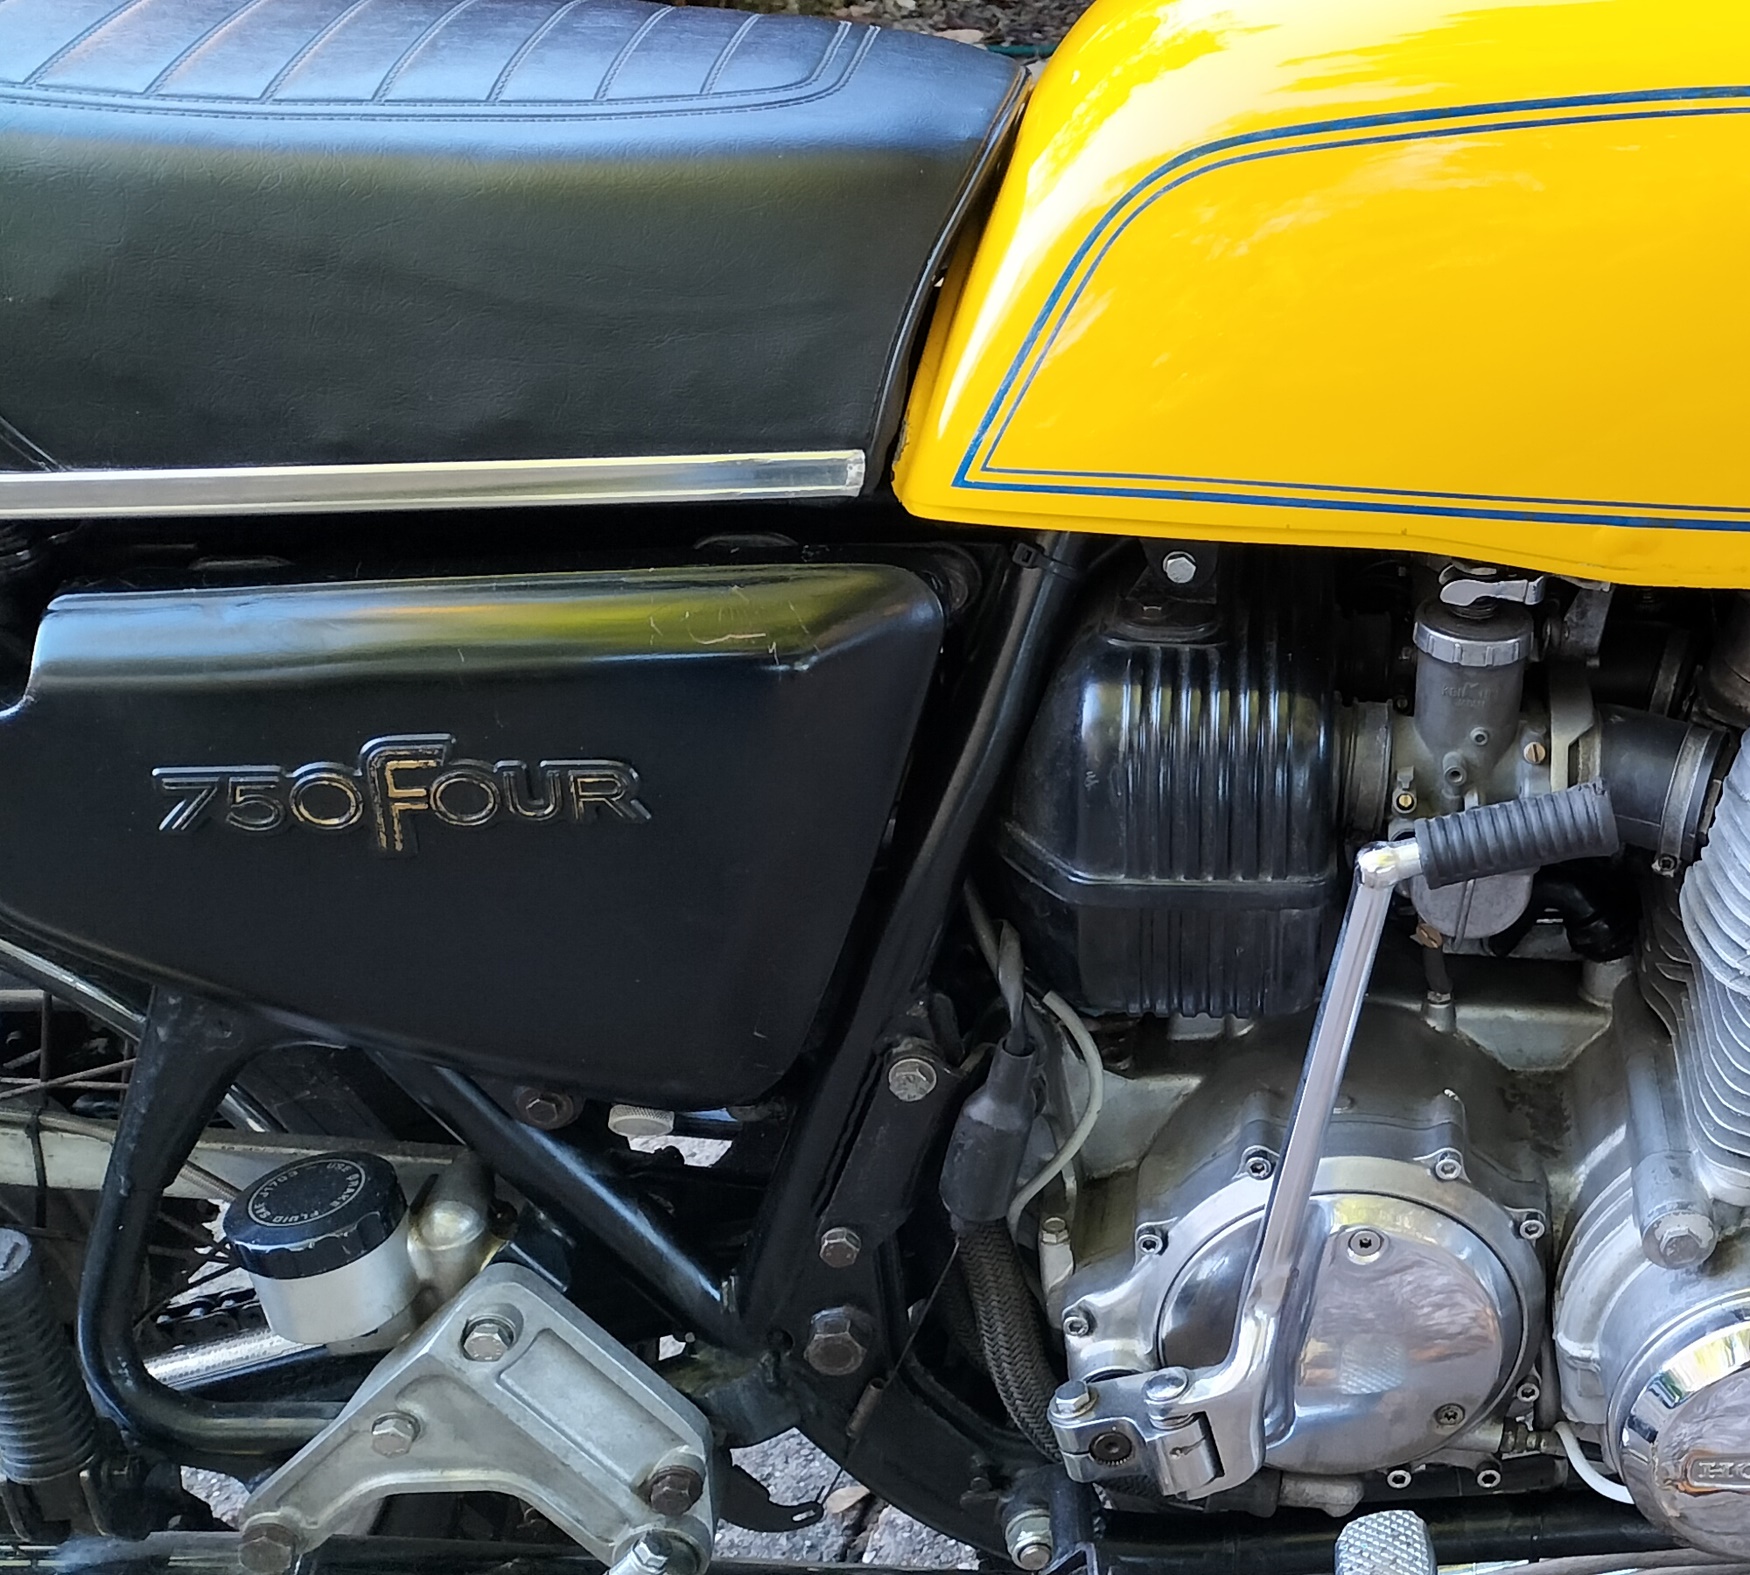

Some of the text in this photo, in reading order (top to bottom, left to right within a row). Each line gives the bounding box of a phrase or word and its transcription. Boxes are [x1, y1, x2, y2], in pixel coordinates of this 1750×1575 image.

[326, 1162, 351, 1173] USE
[329, 1173, 359, 1207] BRAKE
[271, 1210, 320, 1224] FLUID
